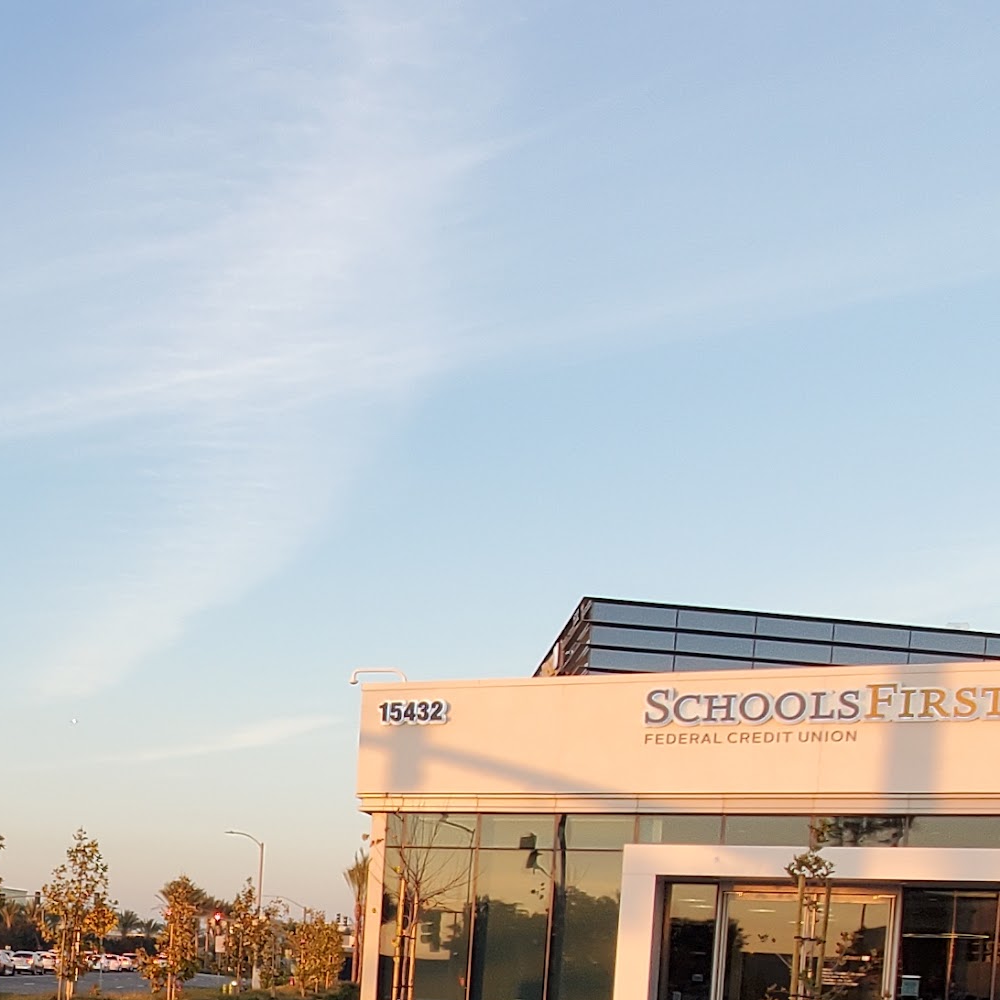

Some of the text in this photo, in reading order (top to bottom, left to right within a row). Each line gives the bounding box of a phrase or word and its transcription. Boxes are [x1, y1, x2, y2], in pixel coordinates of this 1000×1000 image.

[379, 701, 444, 721] 15432
[644, 730, 858, 745] FEDERAL CREDIT UNION
